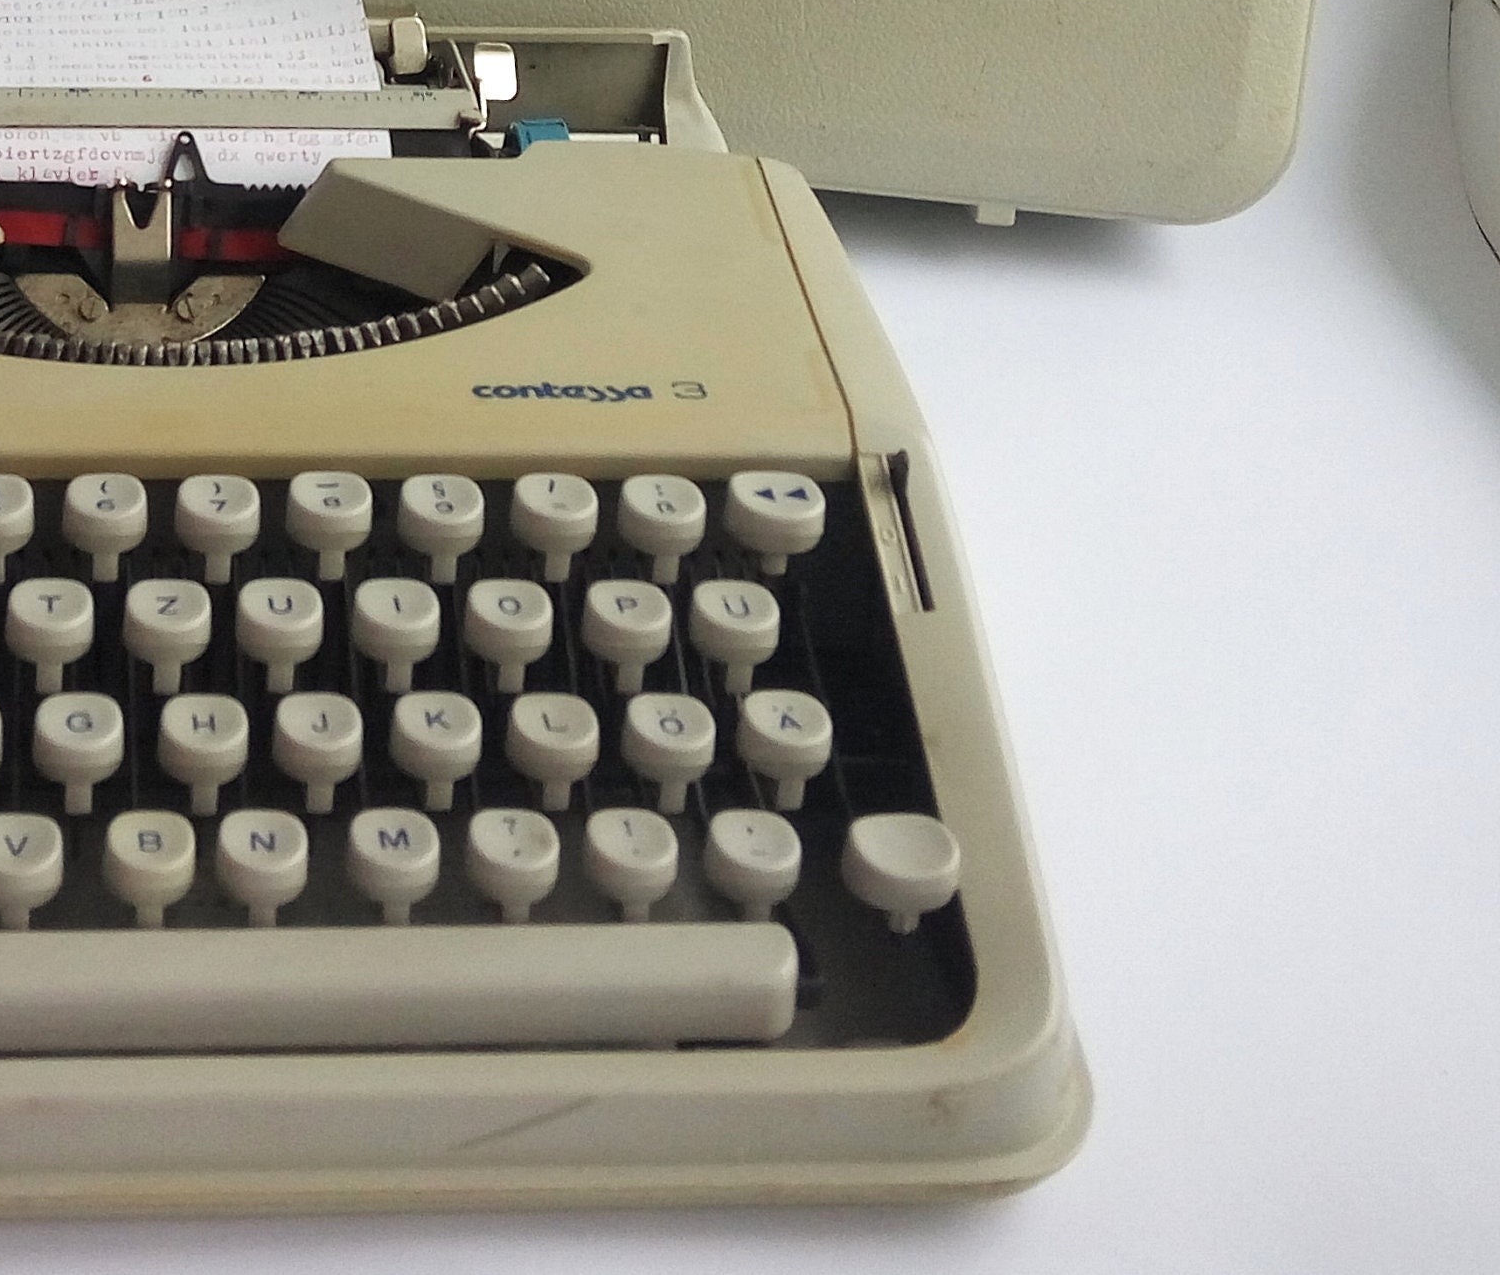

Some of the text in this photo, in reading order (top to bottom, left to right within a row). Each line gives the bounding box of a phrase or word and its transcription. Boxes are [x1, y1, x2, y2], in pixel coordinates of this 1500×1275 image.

[254, 149, 322, 165] qwerty
[471, 380, 708, 402] contessa 3
[39, 595, 61, 614] T
[157, 596, 178, 615] Z
[267, 596, 293, 614] U
[497, 596, 522, 615] O
[615, 597, 638, 614] P
[65, 712, 94, 732] G
[191, 714, 216, 733] H
[311, 712, 329, 733] J
[424, 710, 450, 730] K
[541, 713, 569, 732] L
[4, 835, 29, 858] V
[137, 831, 163, 853] B
[249, 831, 276, 852] N
[377, 828, 410, 849] M
